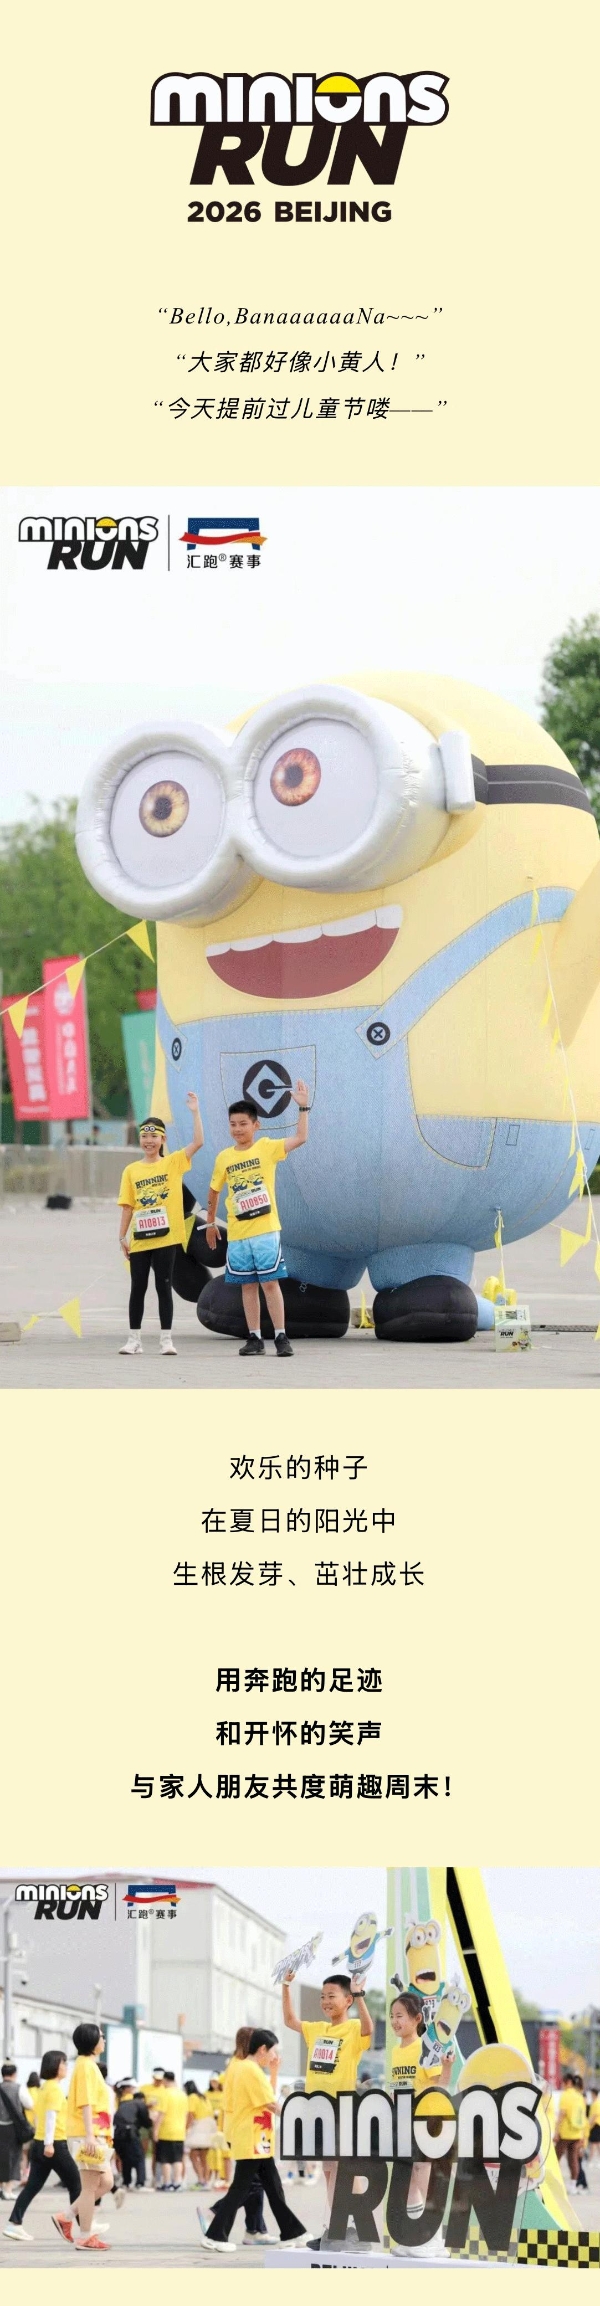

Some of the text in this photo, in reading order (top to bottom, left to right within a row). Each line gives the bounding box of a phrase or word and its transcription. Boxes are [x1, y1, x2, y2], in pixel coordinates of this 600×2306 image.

[240, 1193, 269, 1212] A10850
[138, 1216, 166, 1230] A10813
[328, 2158, 524, 2252] RUN
